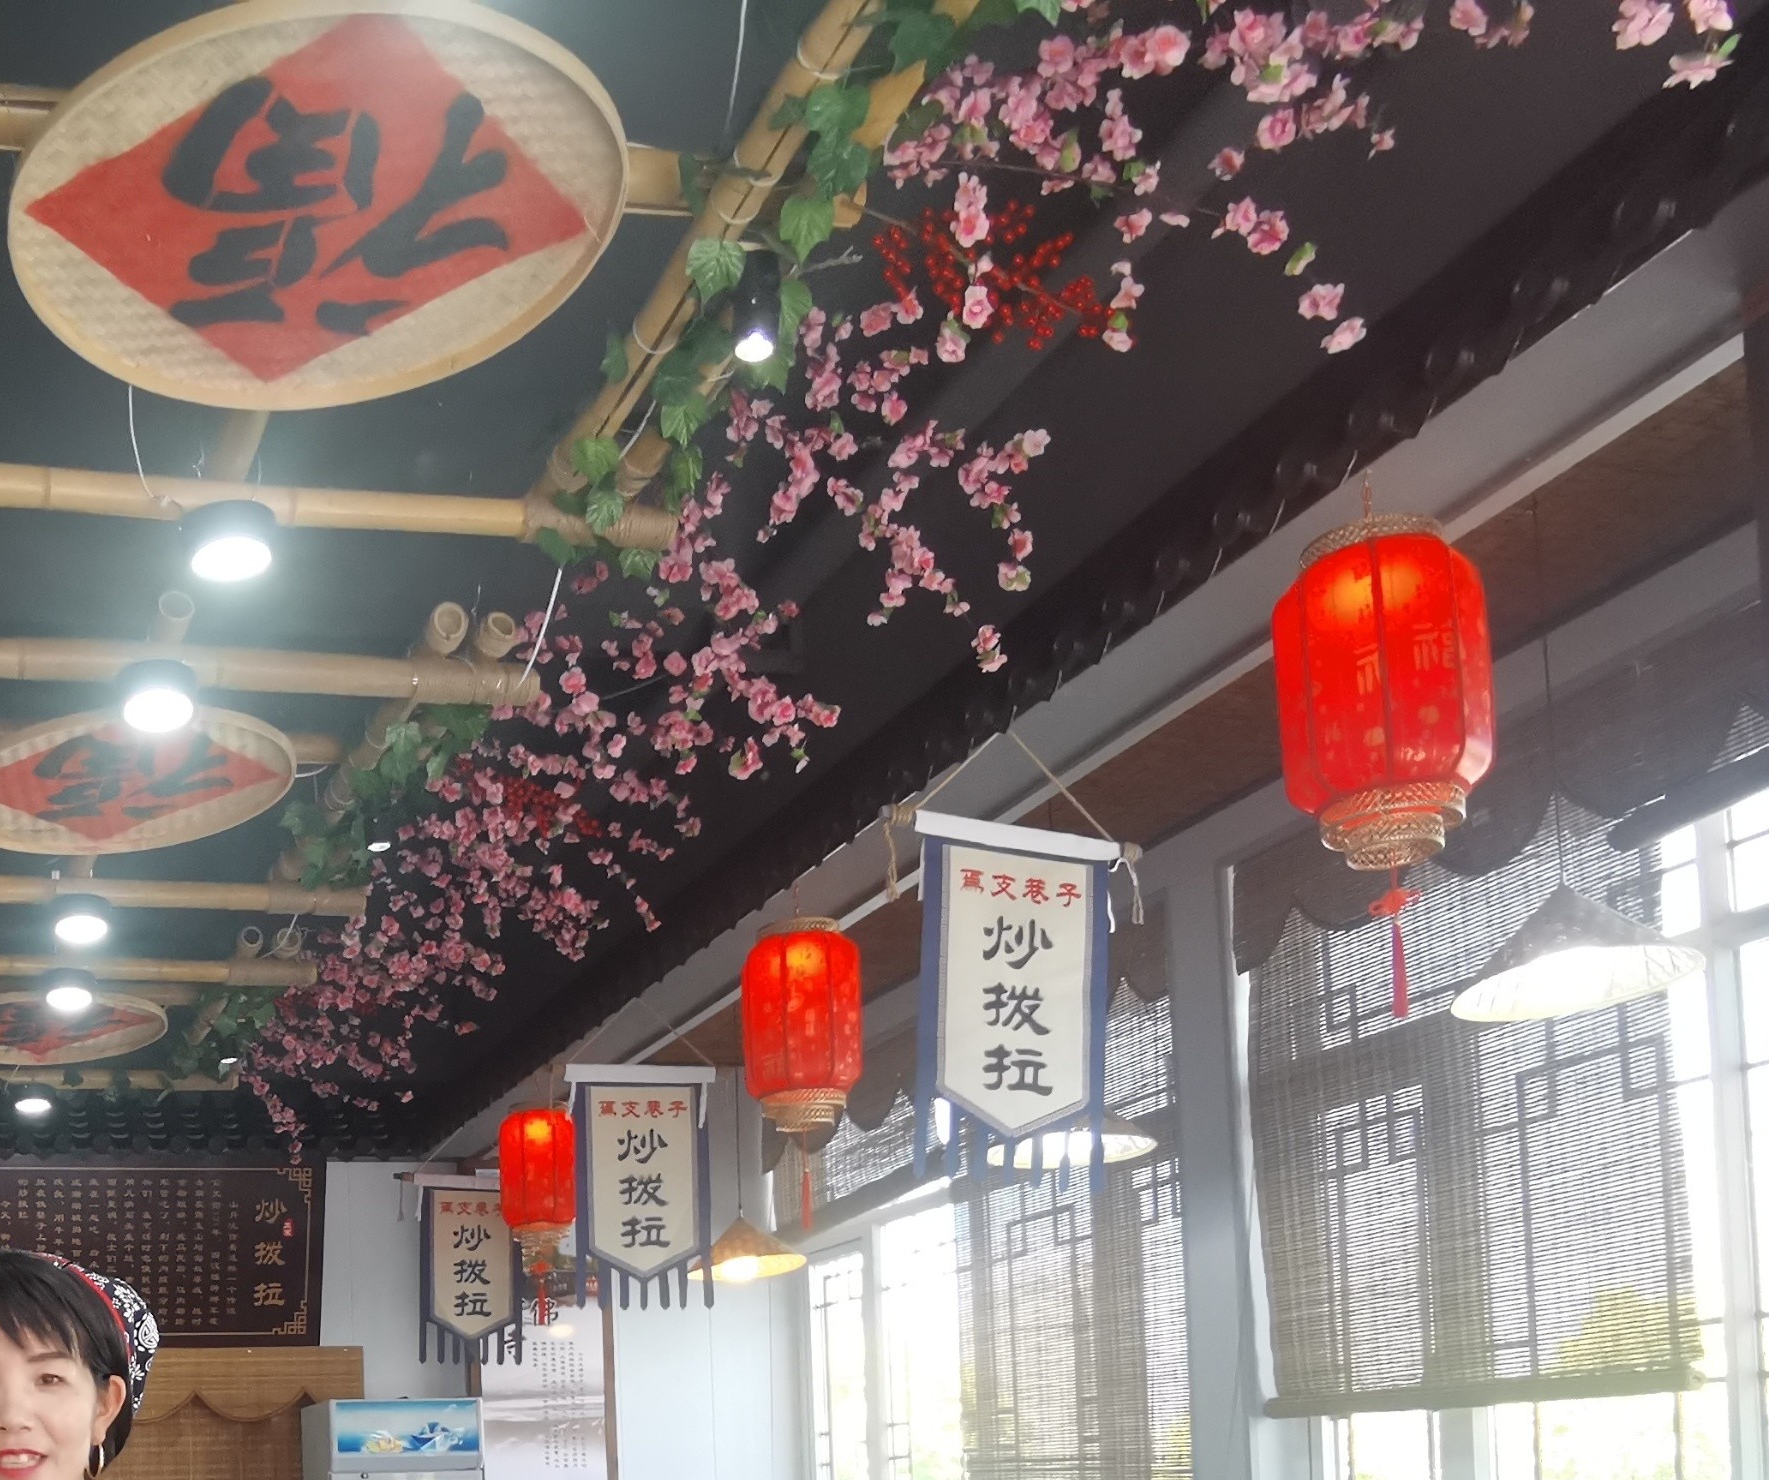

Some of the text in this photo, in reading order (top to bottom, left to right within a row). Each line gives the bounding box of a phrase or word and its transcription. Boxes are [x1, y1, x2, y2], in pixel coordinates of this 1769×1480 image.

[982, 915, 1054, 1097] 炒拨拉
[617, 1129, 671, 1249] 炒拨拉
[253, 1199, 288, 1308] 炒拨拉
[452, 1224, 492, 1318] 炒拨拉
